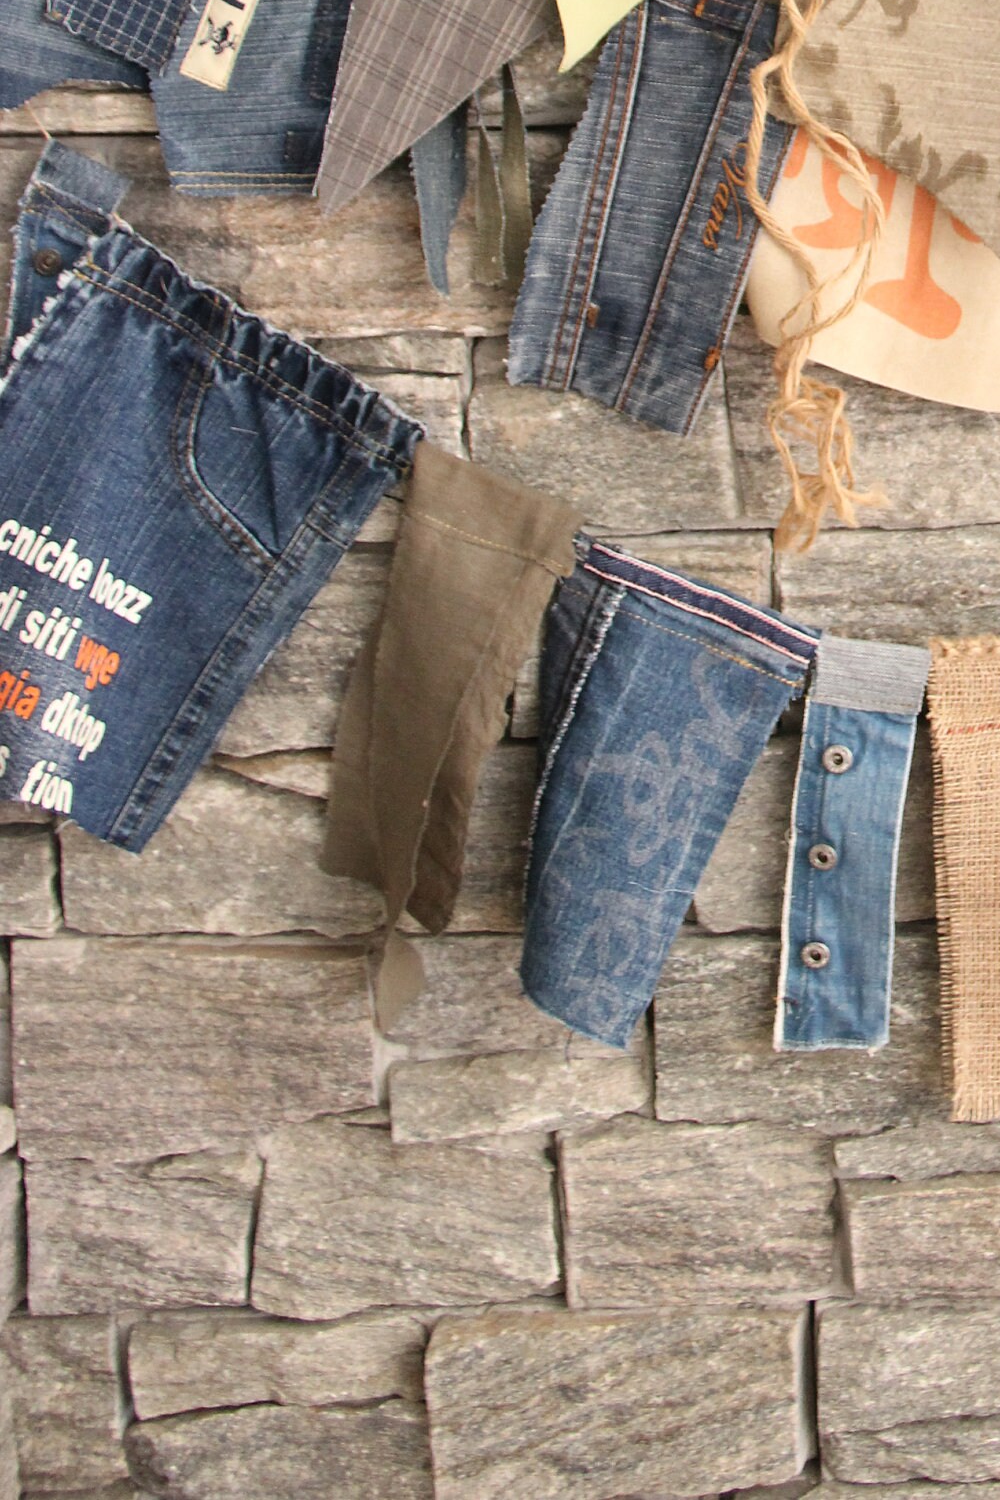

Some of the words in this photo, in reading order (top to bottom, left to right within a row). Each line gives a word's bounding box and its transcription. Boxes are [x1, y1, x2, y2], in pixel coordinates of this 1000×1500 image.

[19, 607, 83, 660] siti
[41, 691, 106, 761] dktop
[20, 759, 73, 814] tion
